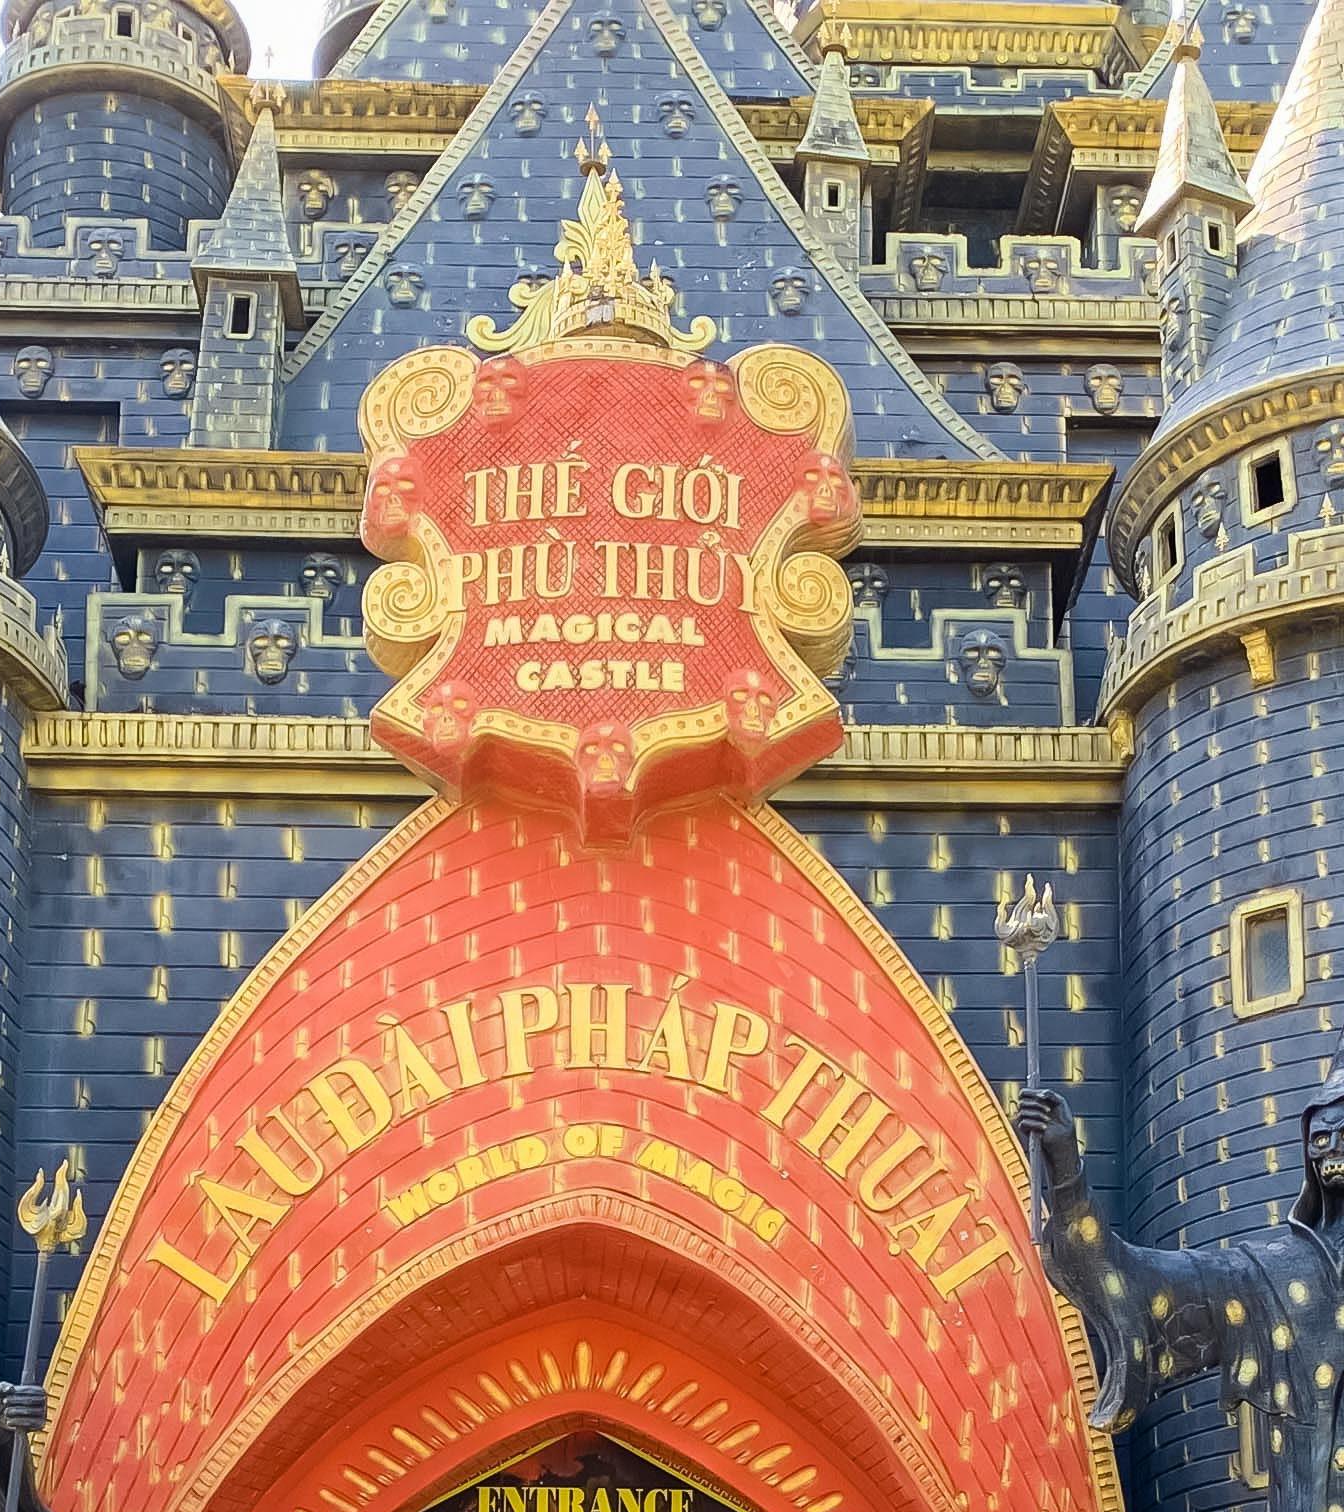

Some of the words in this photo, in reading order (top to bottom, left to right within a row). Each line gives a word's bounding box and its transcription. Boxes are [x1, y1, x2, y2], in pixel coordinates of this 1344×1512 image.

[464, 440, 592, 528] THẾ
[610, 454, 746, 530] GIỚI
[446, 527, 578, 614] PHÙ
[593, 530, 768, 614] THỦY
[483, 613, 706, 649] MAGICAL
[515, 659, 686, 694] CASTLE
[146, 1167, 326, 1304] LÂU
[304, 1012, 489, 1154] ĐÀI
[498, 974, 772, 1095] PHÁP
[759, 1034, 1024, 1302] THUẬT
[381, 1134, 549, 1227] WORLD
[562, 1123, 626, 1159] OF
[634, 1139, 788, 1243] MAGIC
